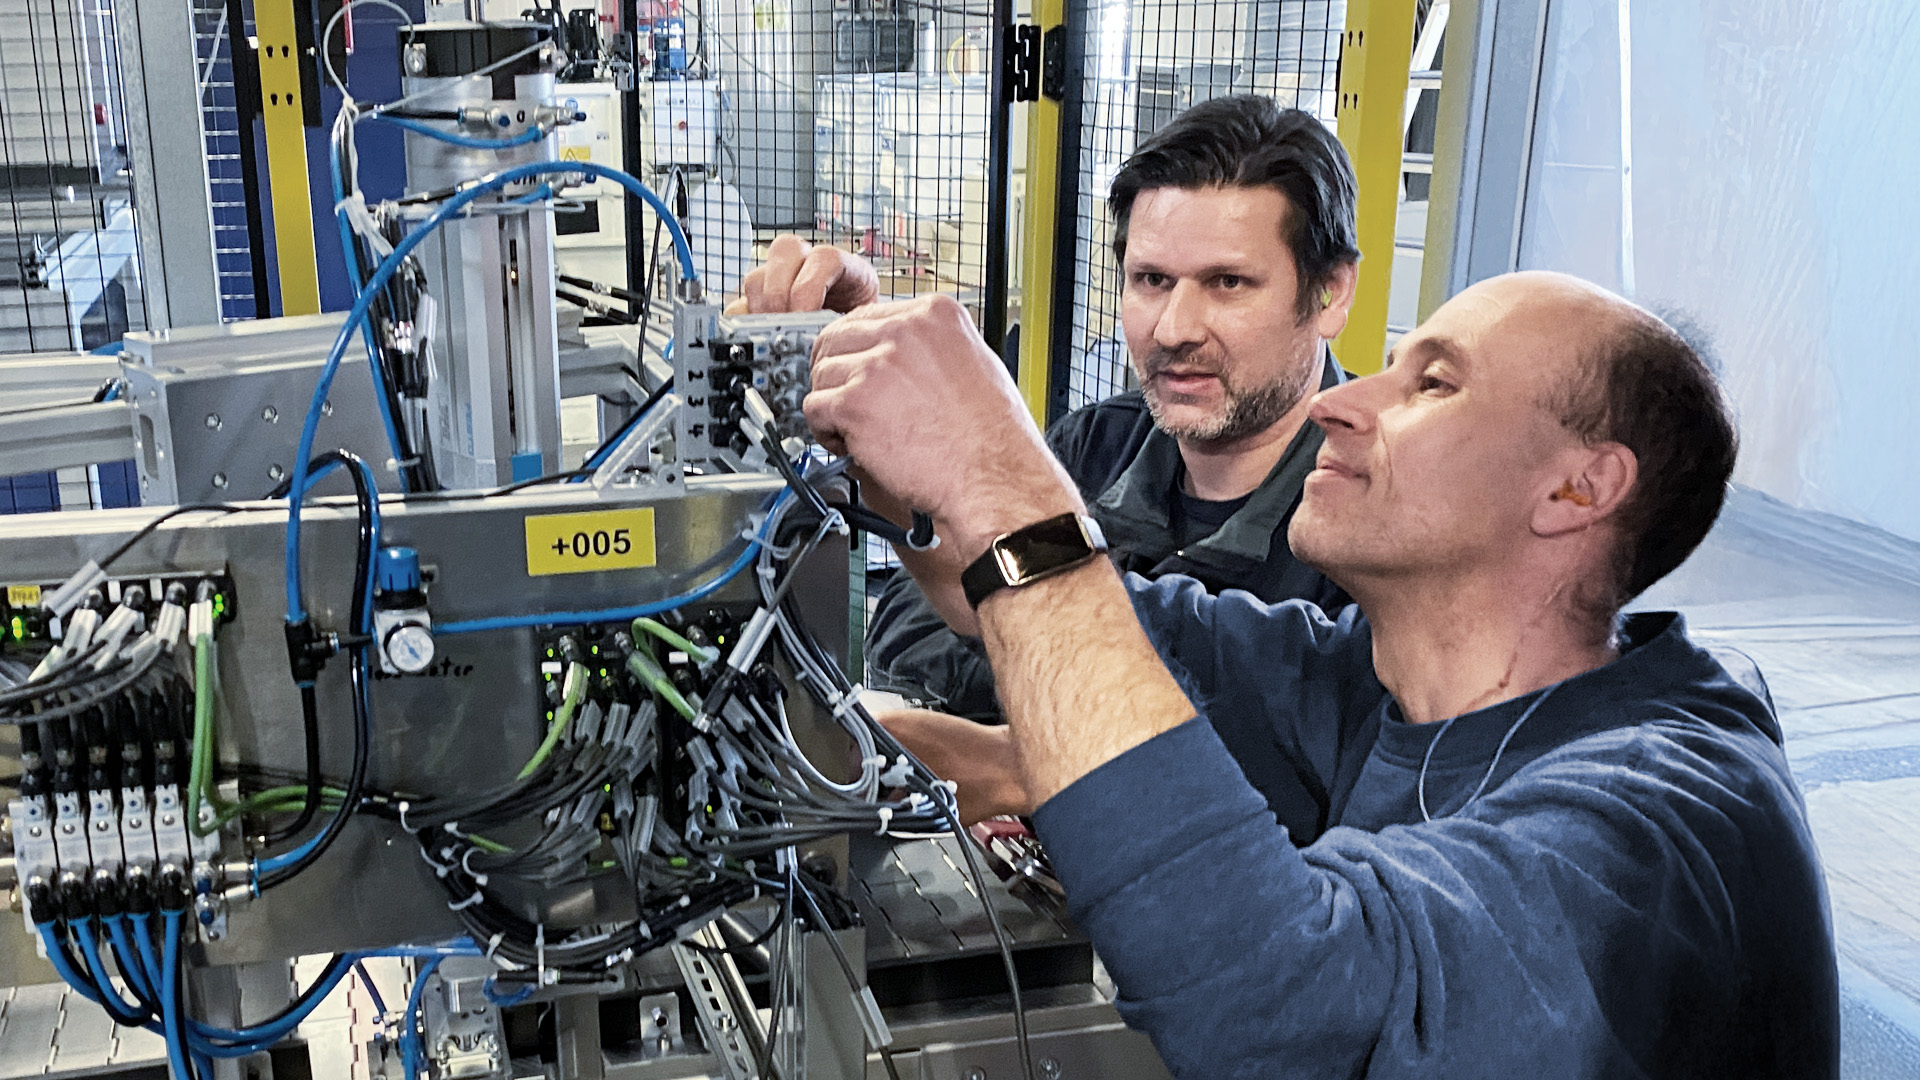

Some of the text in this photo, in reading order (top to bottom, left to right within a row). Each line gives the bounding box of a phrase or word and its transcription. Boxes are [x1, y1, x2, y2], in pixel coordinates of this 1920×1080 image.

[688, 370, 704, 382] 2
[688, 395, 704, 408] 3
[688, 424, 704, 439] 4
[551, 528, 632, 558] +005
